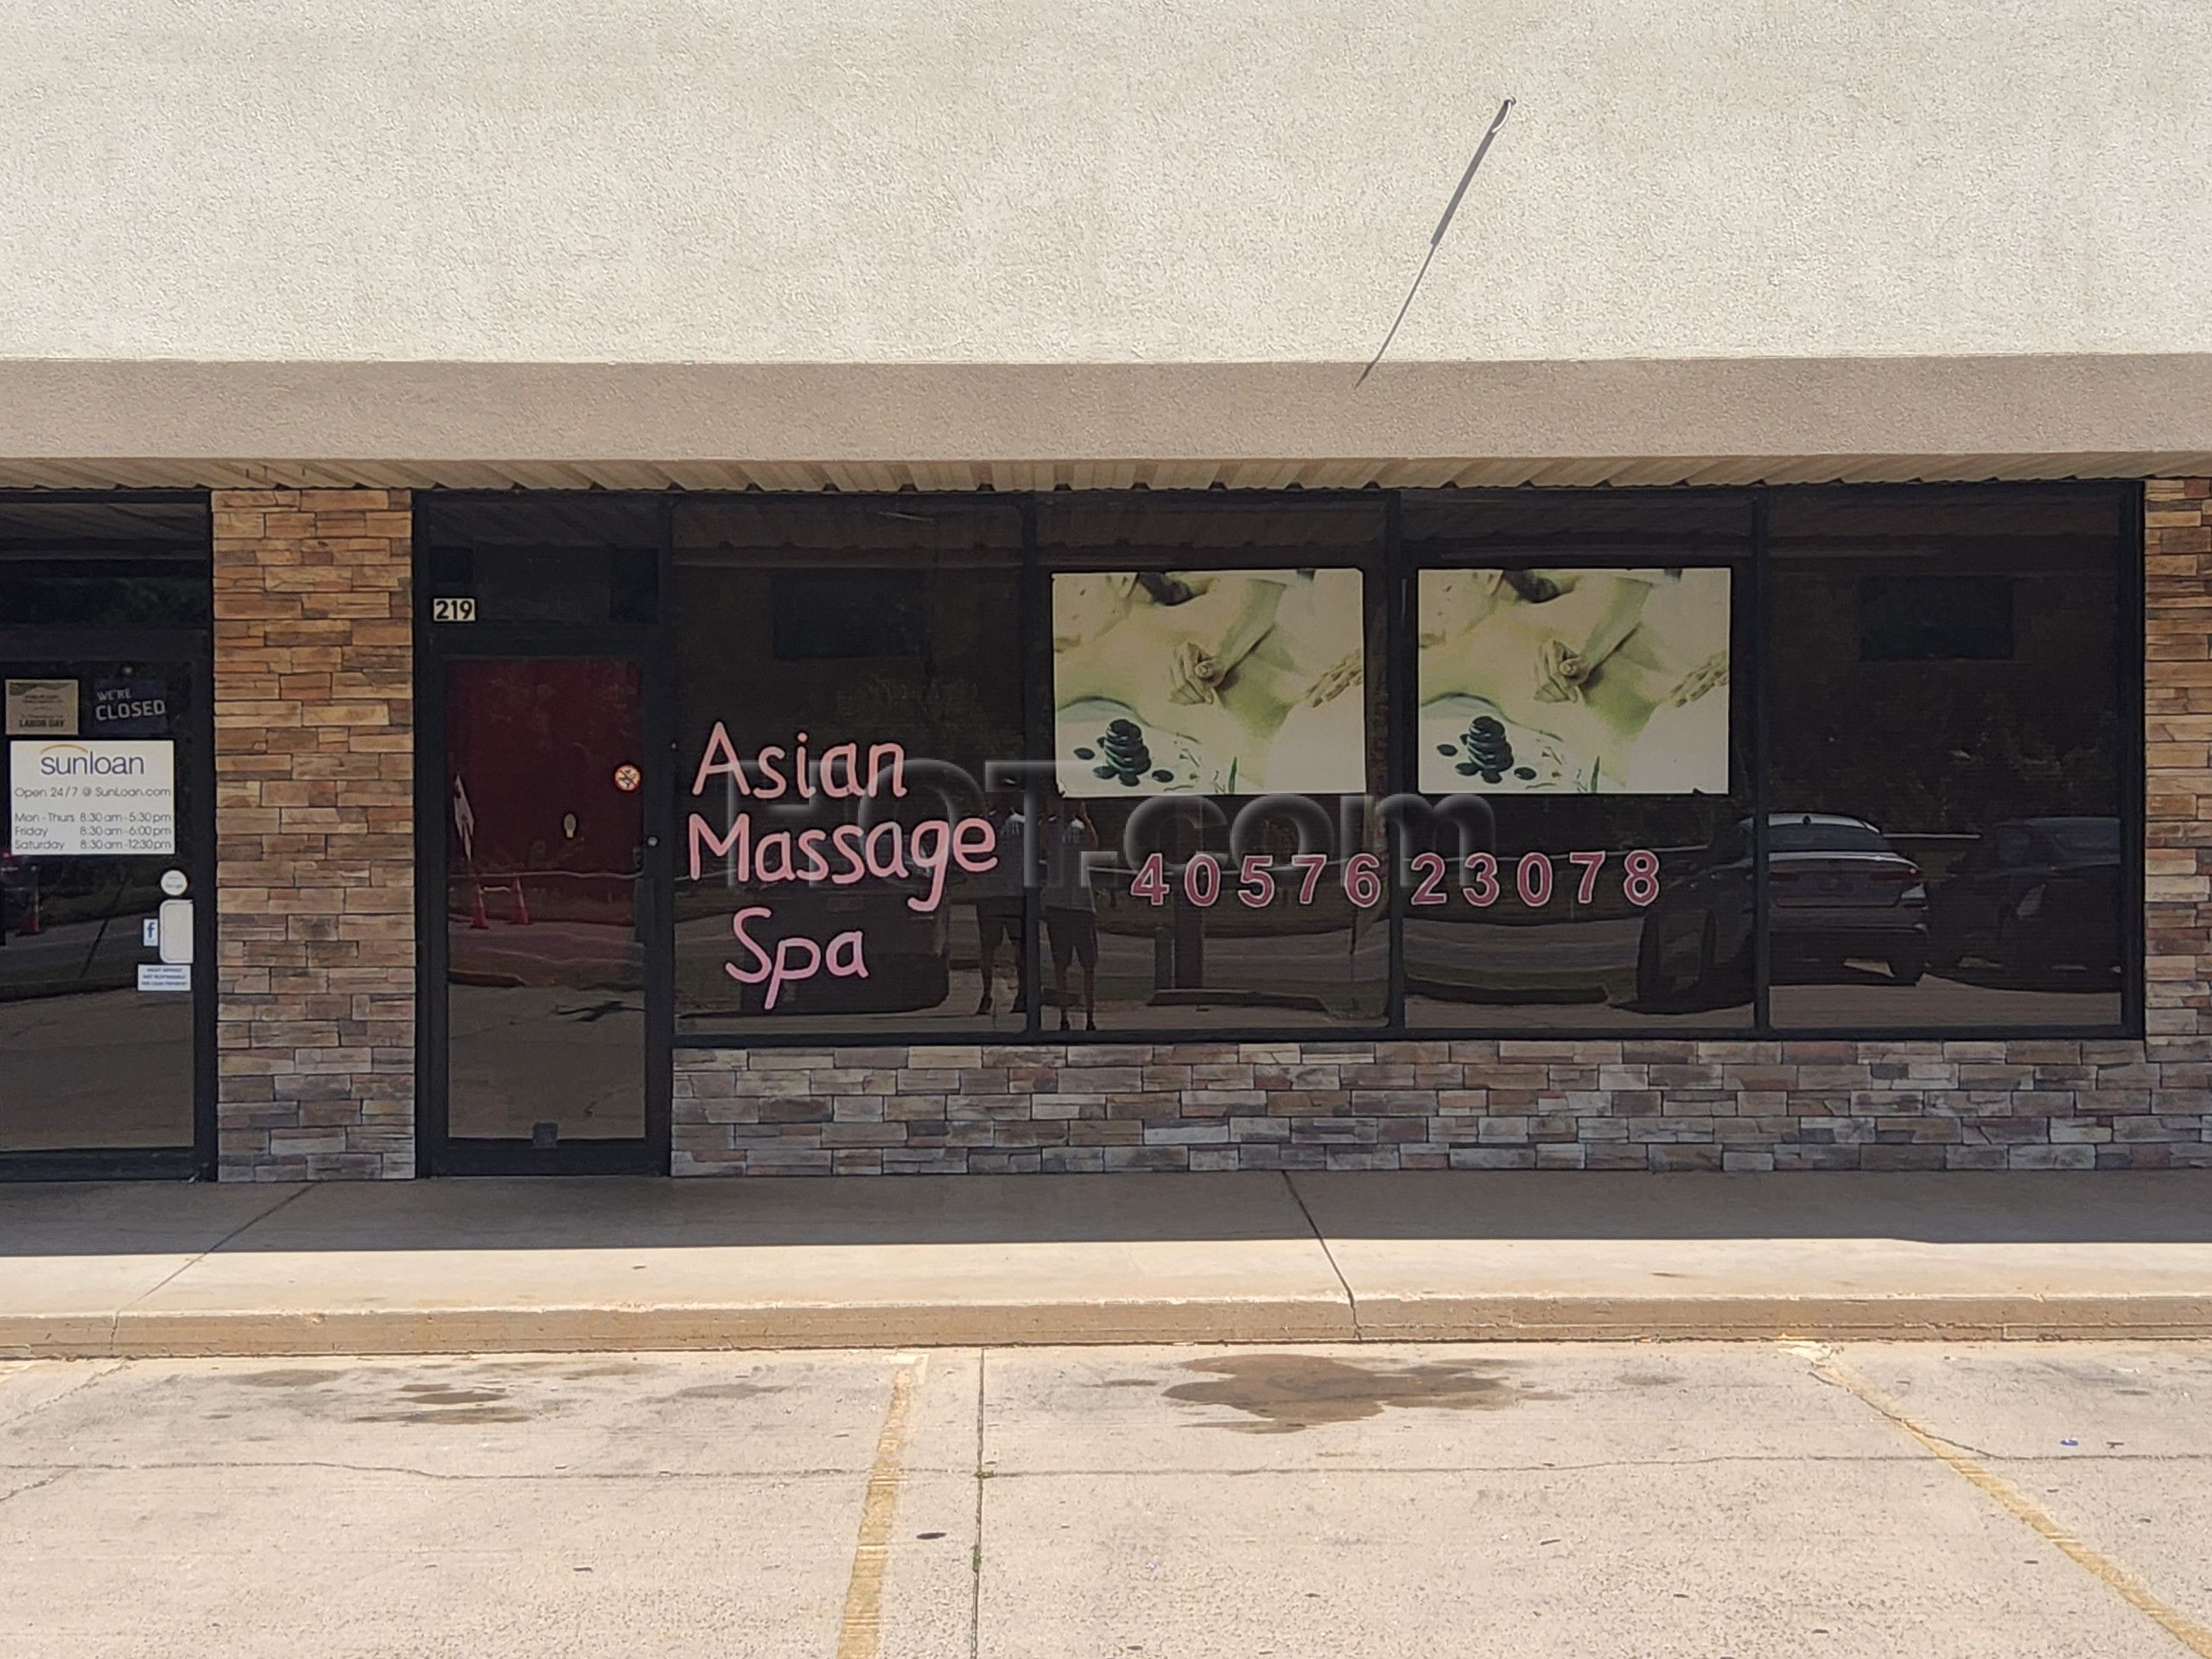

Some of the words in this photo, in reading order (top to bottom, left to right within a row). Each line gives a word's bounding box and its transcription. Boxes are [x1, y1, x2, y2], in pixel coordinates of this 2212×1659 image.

[435, 601, 473, 620] 219
[96, 700, 166, 721] CLOSED
[40, 751, 145, 775] sunloan
[692, 721, 908, 798] Asian
[14, 787, 48, 799] Open
[95, 786, 171, 798] SunLoan.com
[14, 812, 40, 823] Mon
[48, 812, 75, 823] Thurs
[14, 826, 48, 838] Friday
[15, 839, 66, 851] Saturday
[689, 813, 998, 912] Massage
[726, 907, 869, 1010] Spa
